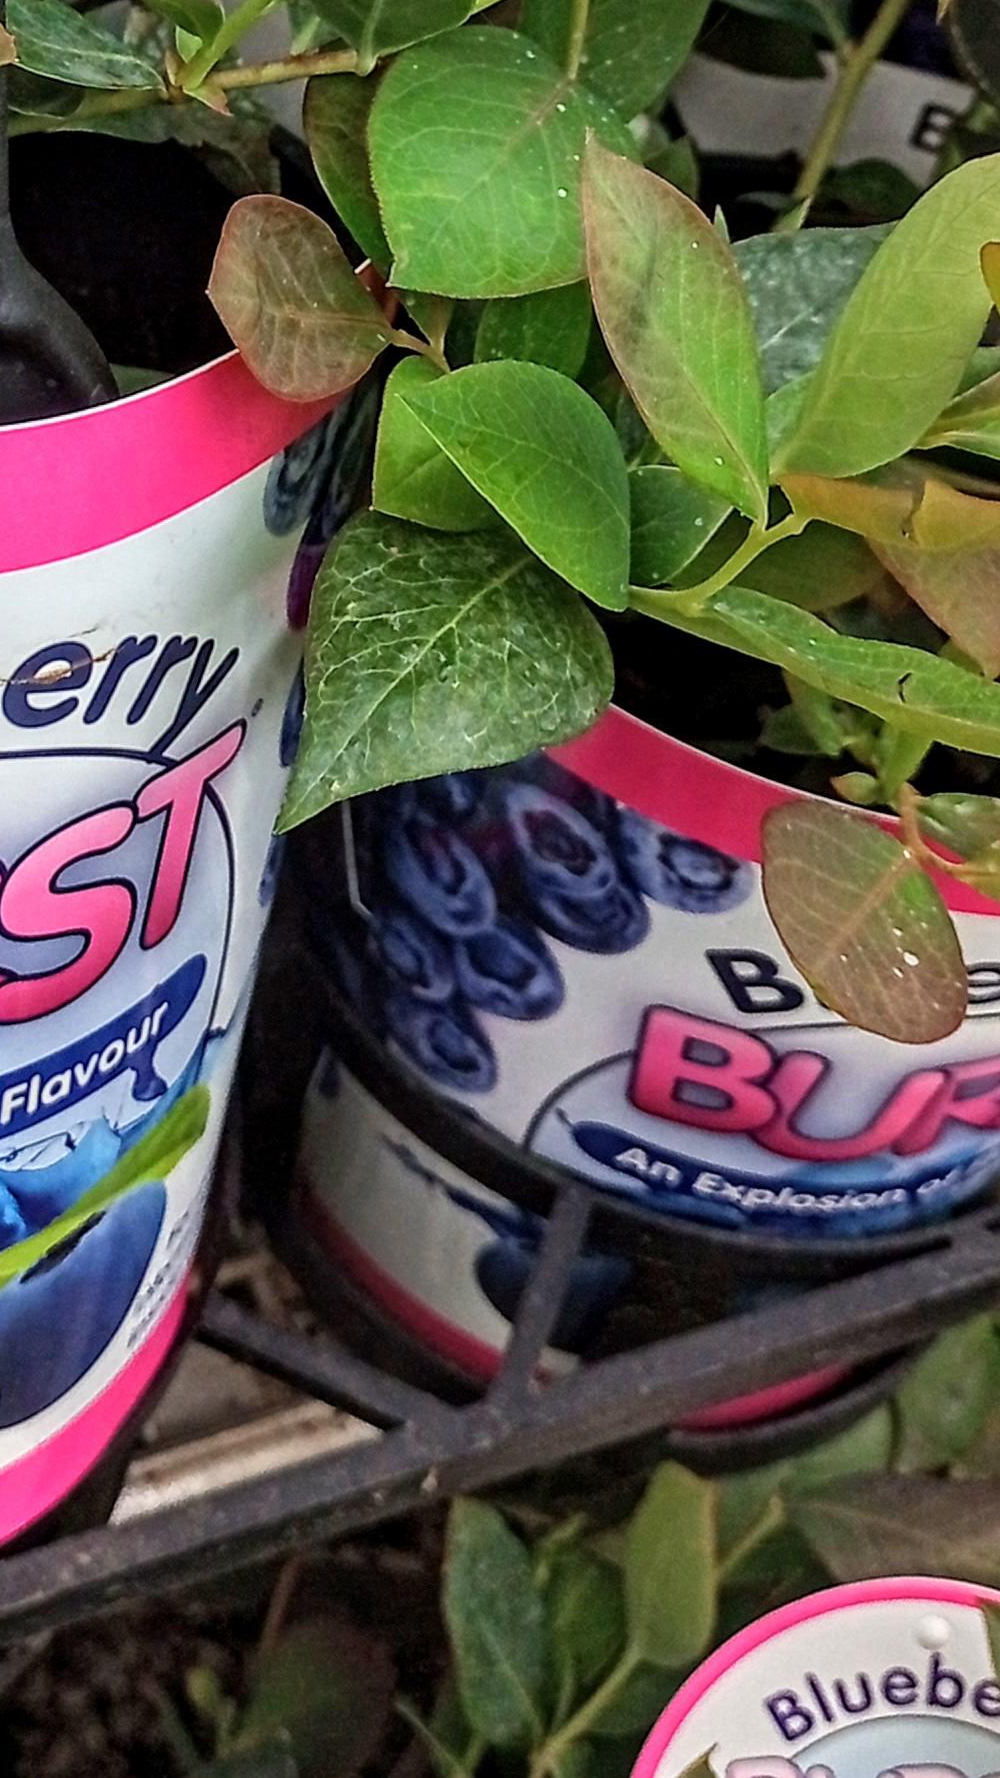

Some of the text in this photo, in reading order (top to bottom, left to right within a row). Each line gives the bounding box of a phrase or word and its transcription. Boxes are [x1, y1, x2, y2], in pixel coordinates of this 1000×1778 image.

[0, 1002, 172, 1124] Flavour
[629, 1003, 1000, 1163] BUR
[614, 1146, 680, 1191] An
[691, 1171, 907, 1211] Explosion
[765, 1651, 1000, 1742] Bluebe
